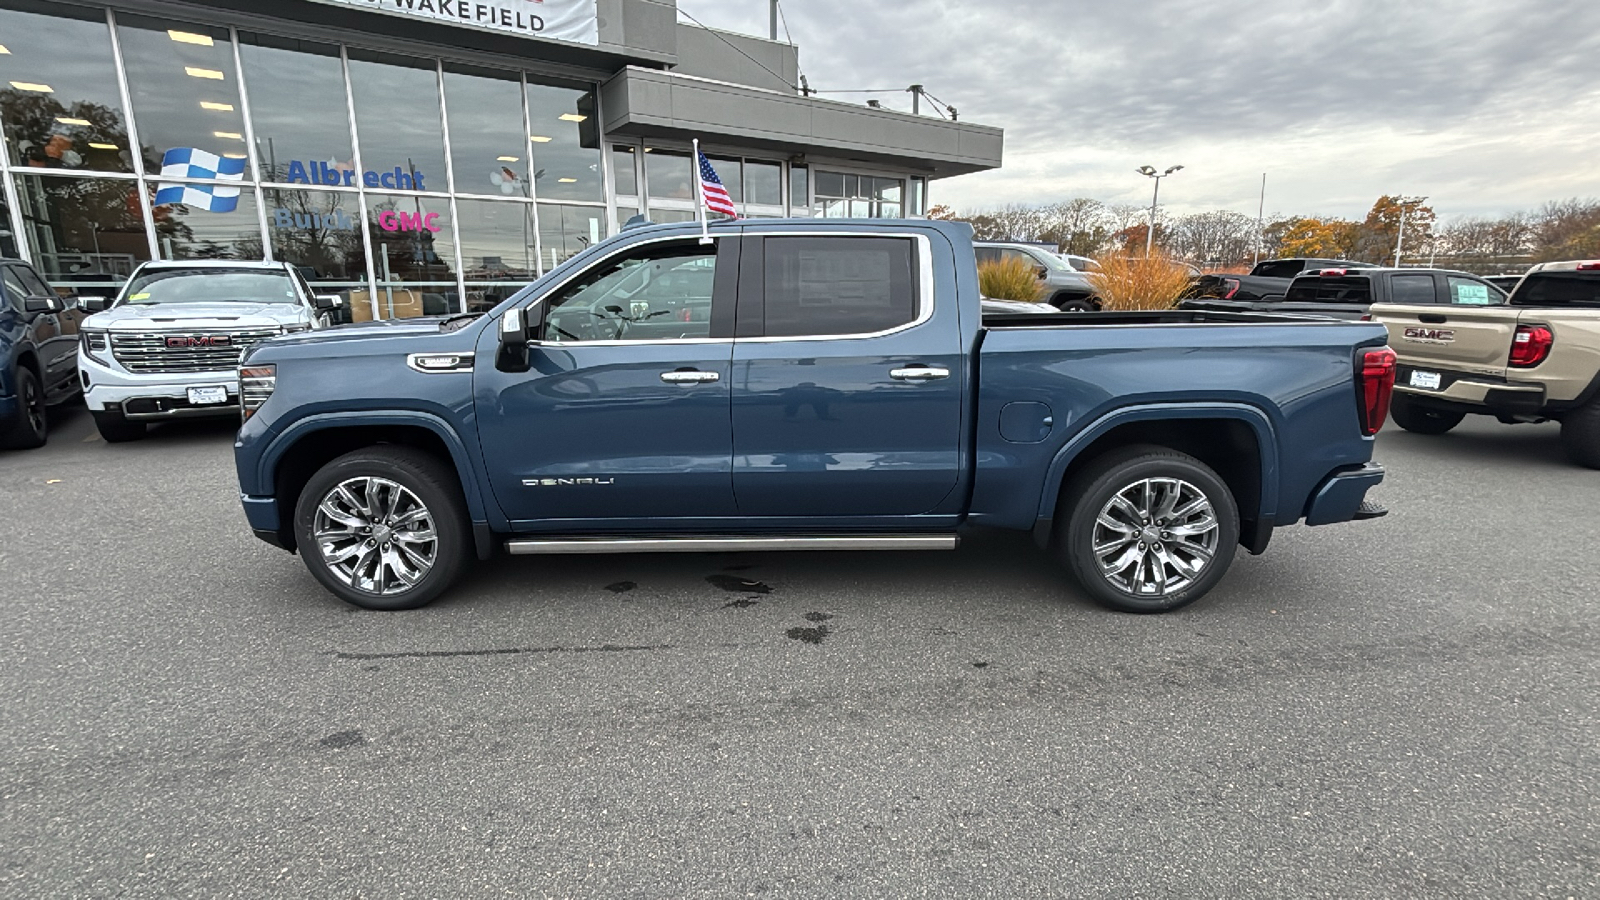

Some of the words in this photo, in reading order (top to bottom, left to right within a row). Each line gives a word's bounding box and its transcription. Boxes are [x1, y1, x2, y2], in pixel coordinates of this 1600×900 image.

[287, 160, 426, 190] Albrecht
[274, 207, 353, 231] Buick
[379, 210, 442, 233] GMC
[166, 335, 230, 347] GMC
[1404, 328, 1455, 341] GMC
[521, 477, 615, 486] DENALI
